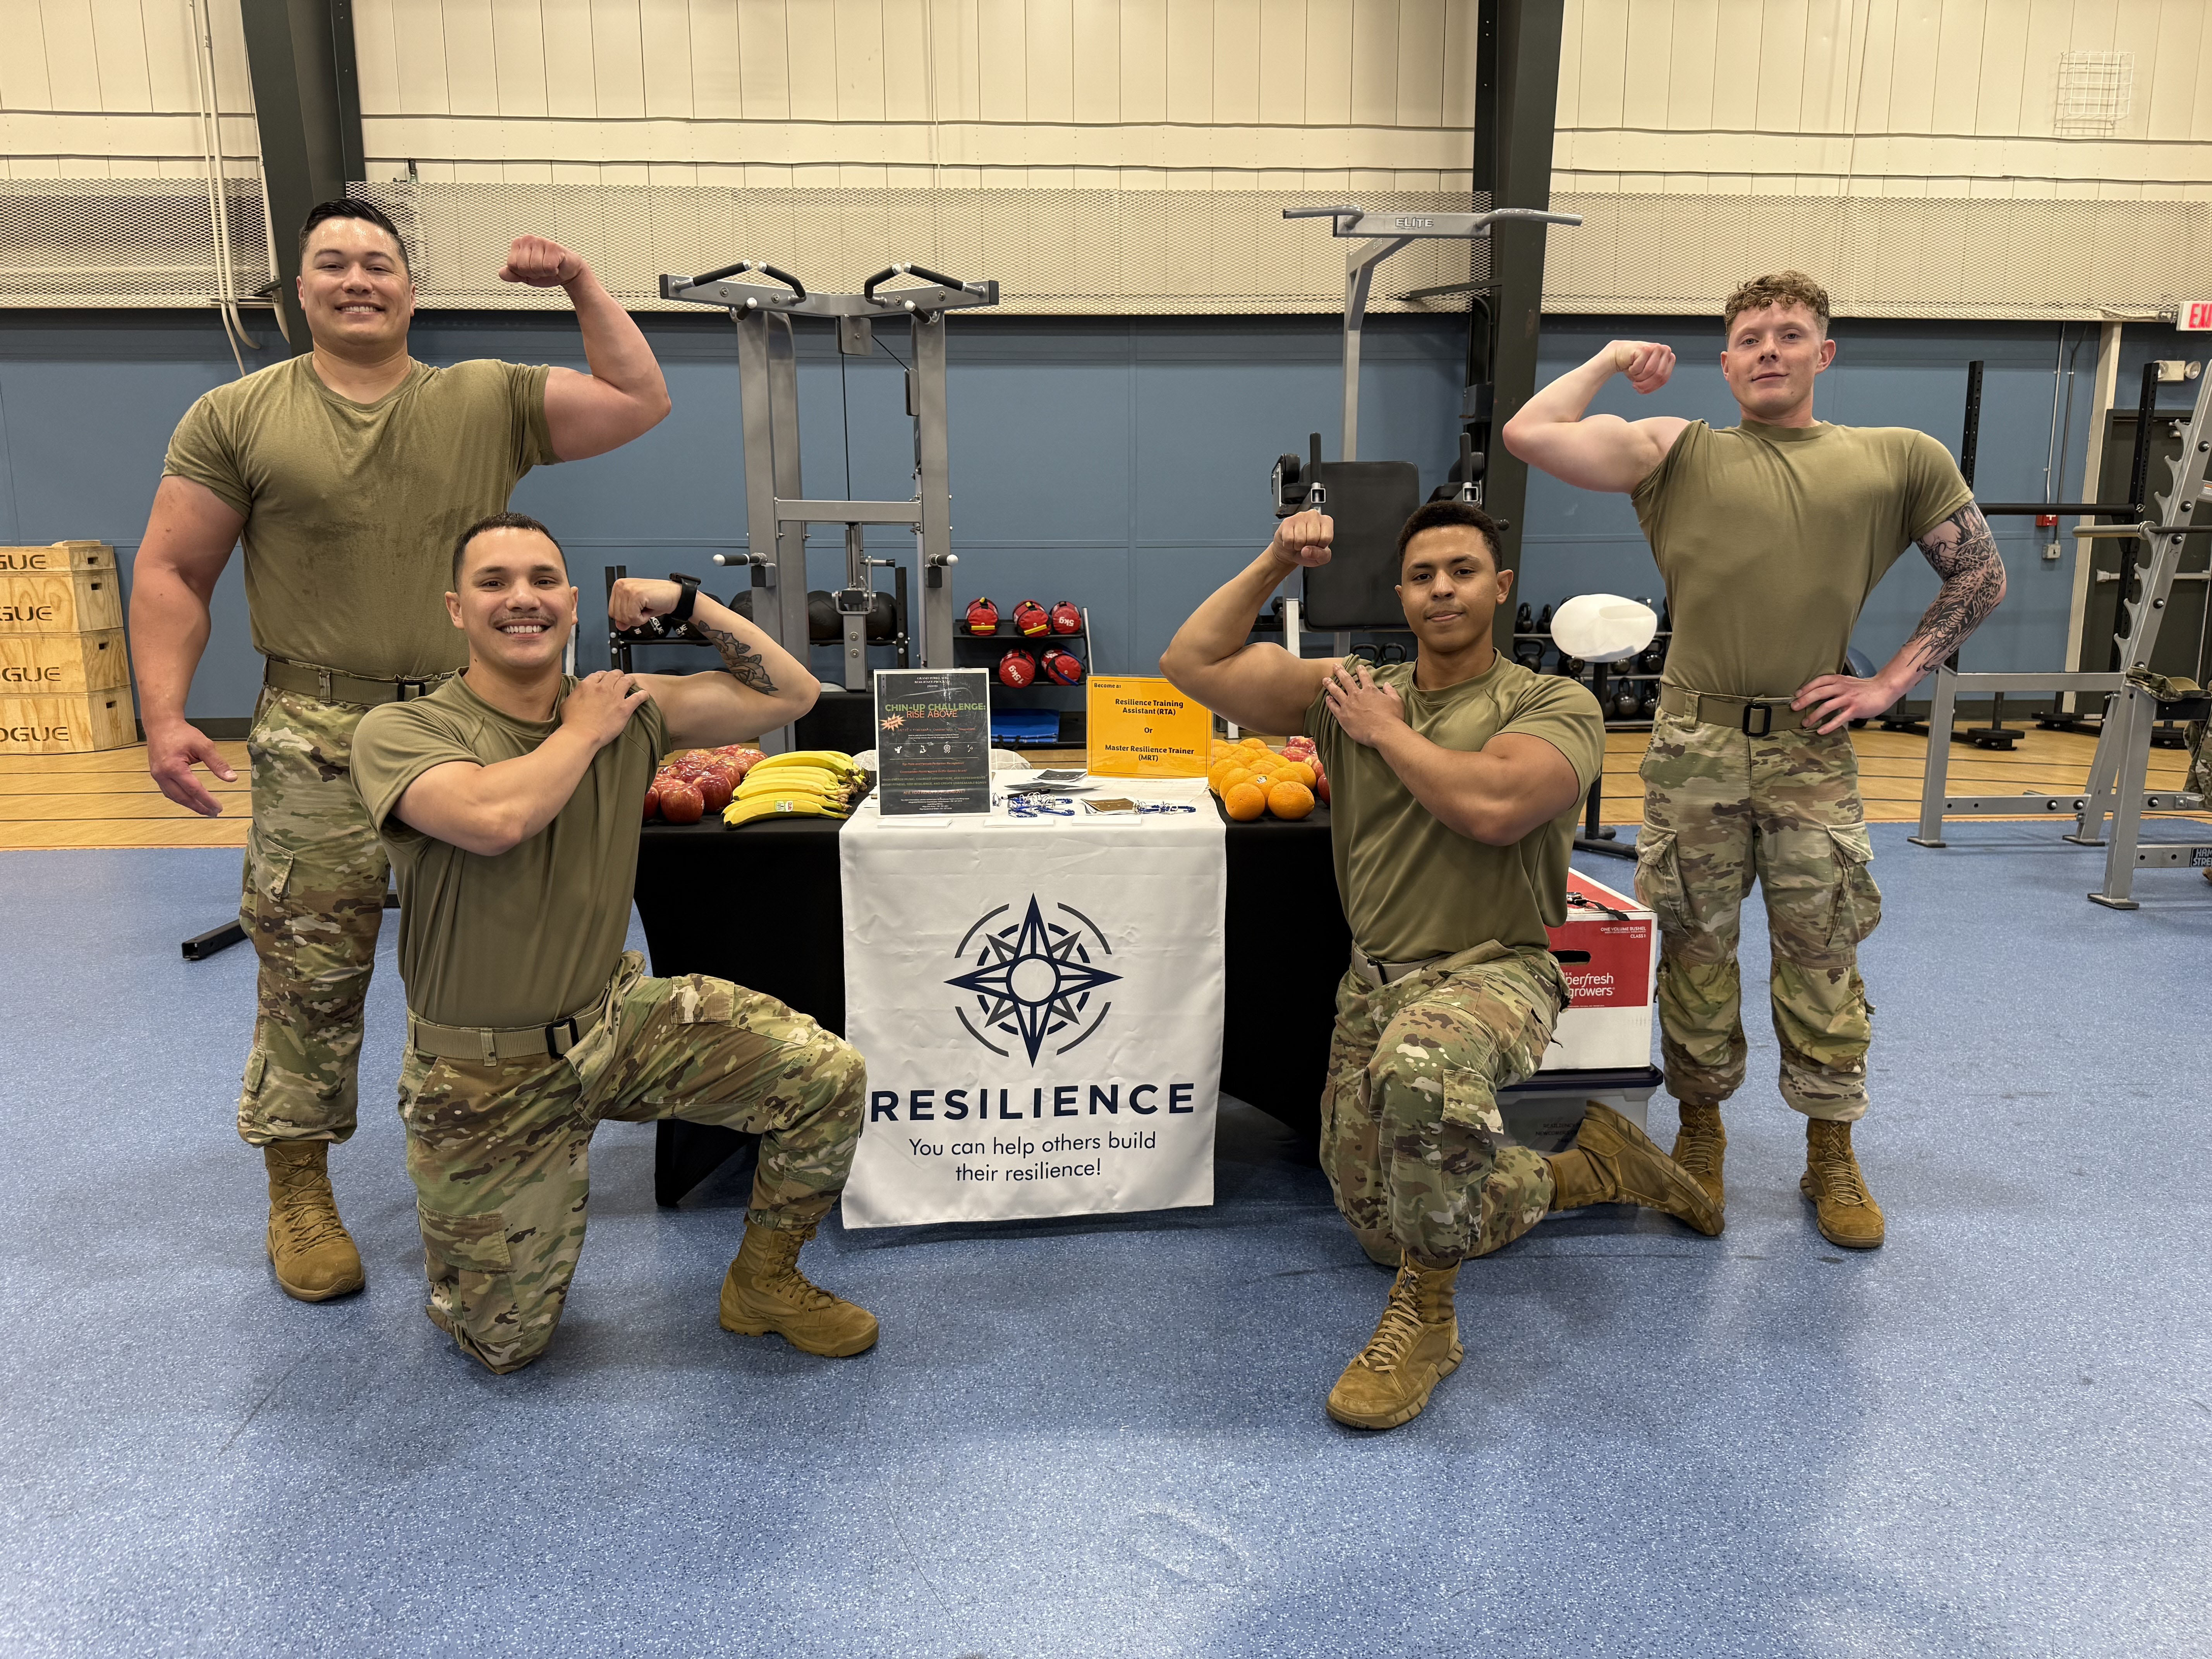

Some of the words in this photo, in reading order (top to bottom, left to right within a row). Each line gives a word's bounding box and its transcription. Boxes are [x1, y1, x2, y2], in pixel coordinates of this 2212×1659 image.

[1395, 217, 1434, 228] ELITE
[1058, 617, 1075, 627] 5kg
[1008, 665, 1025, 684] 15kg
[885, 704, 926, 712] CHIN-UP
[928, 703, 986, 711] CHALLENGE:
[1152, 700, 1184, 709] Training
[907, 710, 925, 718] RISE
[927, 710, 958, 718] ABOVE
[1157, 708, 1176, 716] (RTA)
[1139, 754, 1159, 762] (MRT)
[2193, 857, 2212, 866] STRE
[871, 1083, 1195, 1123] RESILIENCE
[908, 1139, 944, 1156] You
[951, 1143, 985, 1156] can
[993, 1136, 1035, 1159] help
[1042, 1133, 1101, 1152] others
[1108, 1131, 1156, 1149] build
[955, 1163, 998, 1182] their
[1006, 1158, 1101, 1182] resilience!
